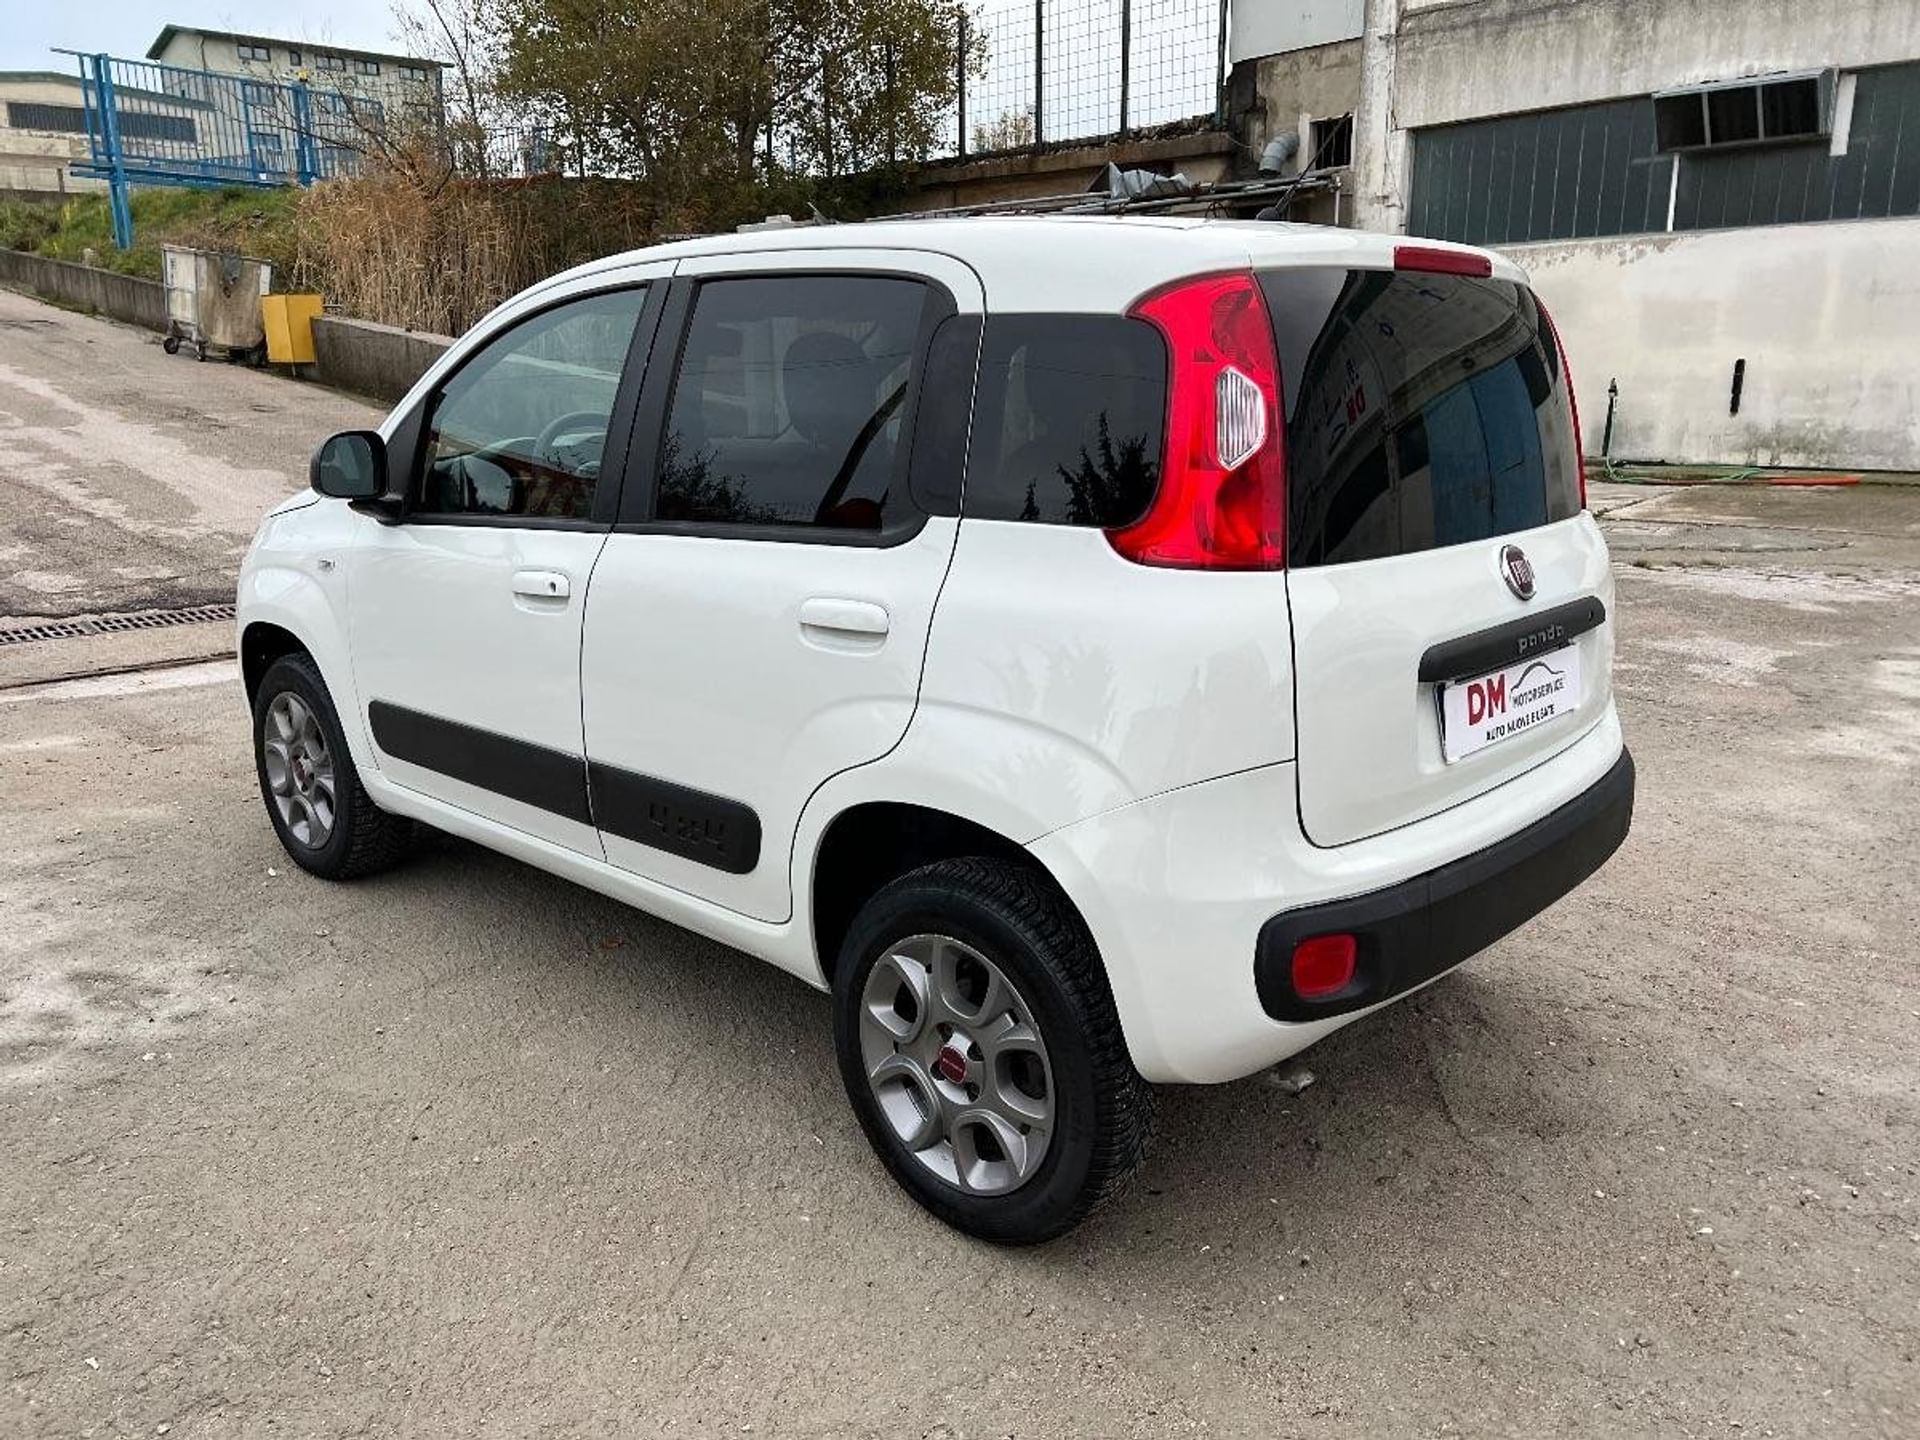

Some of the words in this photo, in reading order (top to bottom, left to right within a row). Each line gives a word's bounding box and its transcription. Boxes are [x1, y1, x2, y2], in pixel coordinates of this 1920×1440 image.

[1466, 673, 1507, 726] DM
[1512, 677, 1565, 708] MOTORSERVICE
[1486, 723, 1505, 741] AUTO
